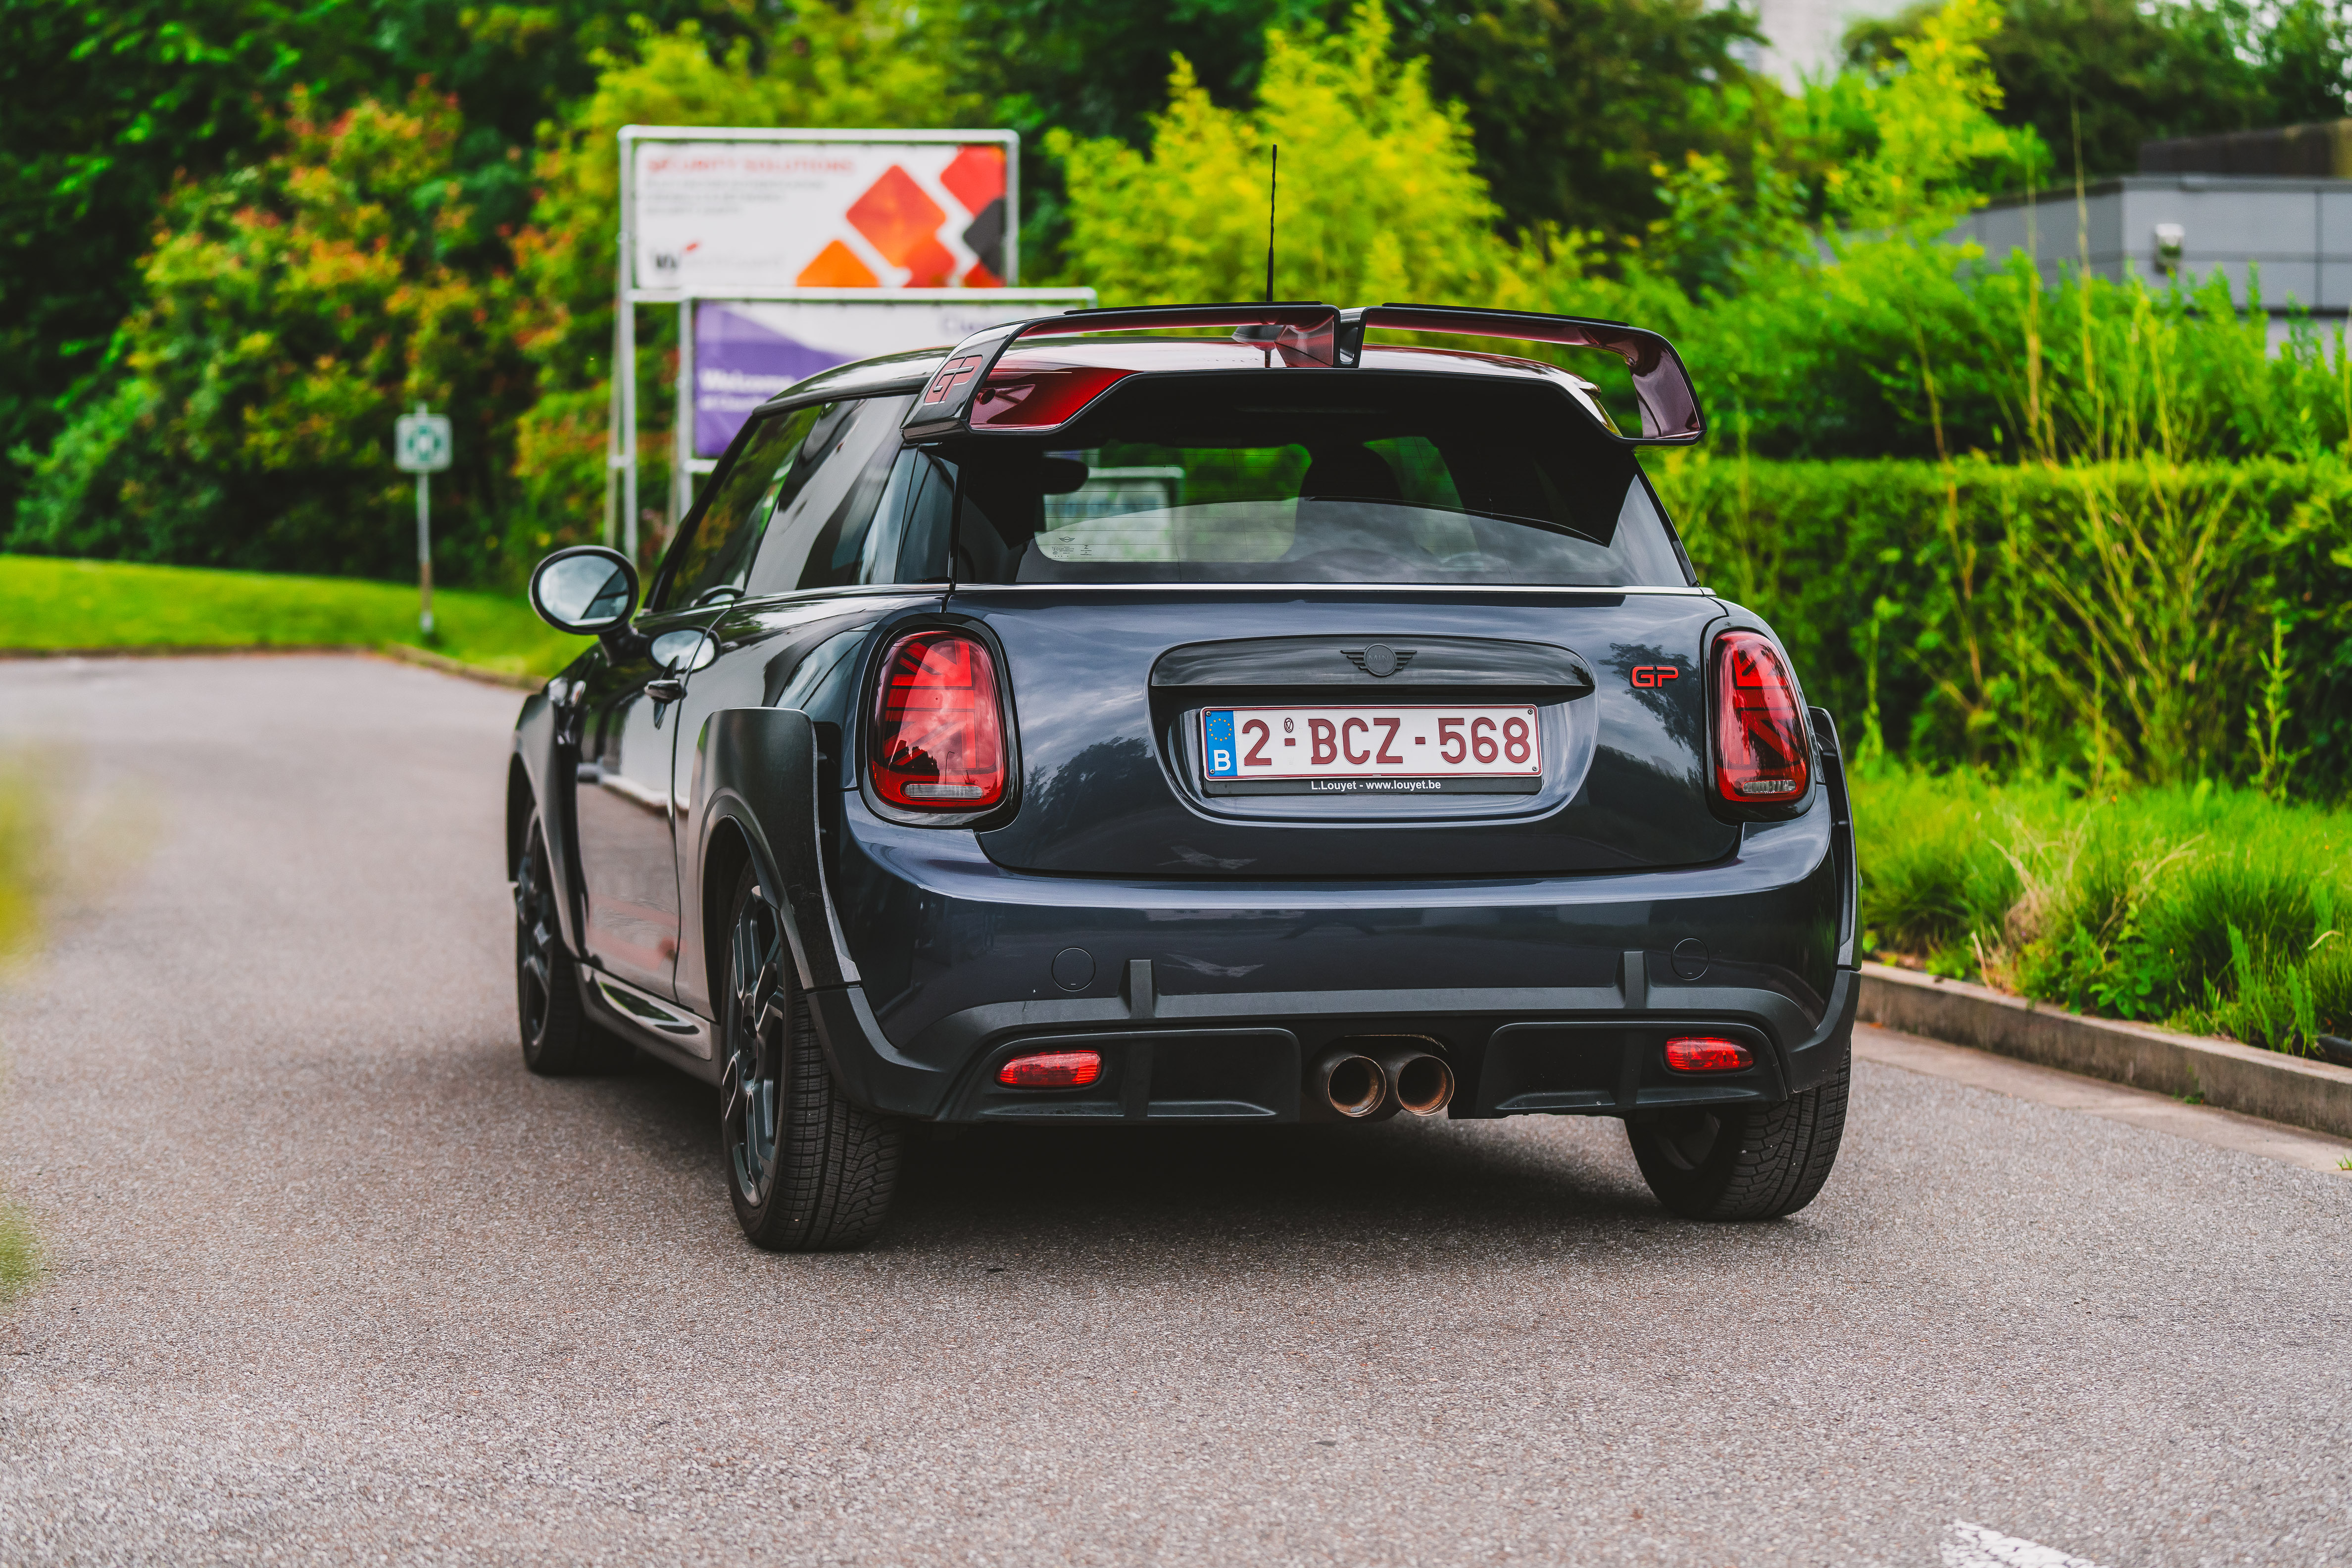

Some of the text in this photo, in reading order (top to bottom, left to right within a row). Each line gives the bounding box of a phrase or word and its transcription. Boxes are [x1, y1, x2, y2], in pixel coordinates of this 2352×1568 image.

[924, 354, 983, 404] GP
[1368, 654, 1393, 663] MINI
[1630, 665, 1679, 687] GP
[1242, 717, 1531, 766] 2-BCZ-568
[1214, 750, 1231, 771] B
[1311, 781, 1357, 792] L.Louyet
[1365, 780, 1441, 791] www.louyet.be
